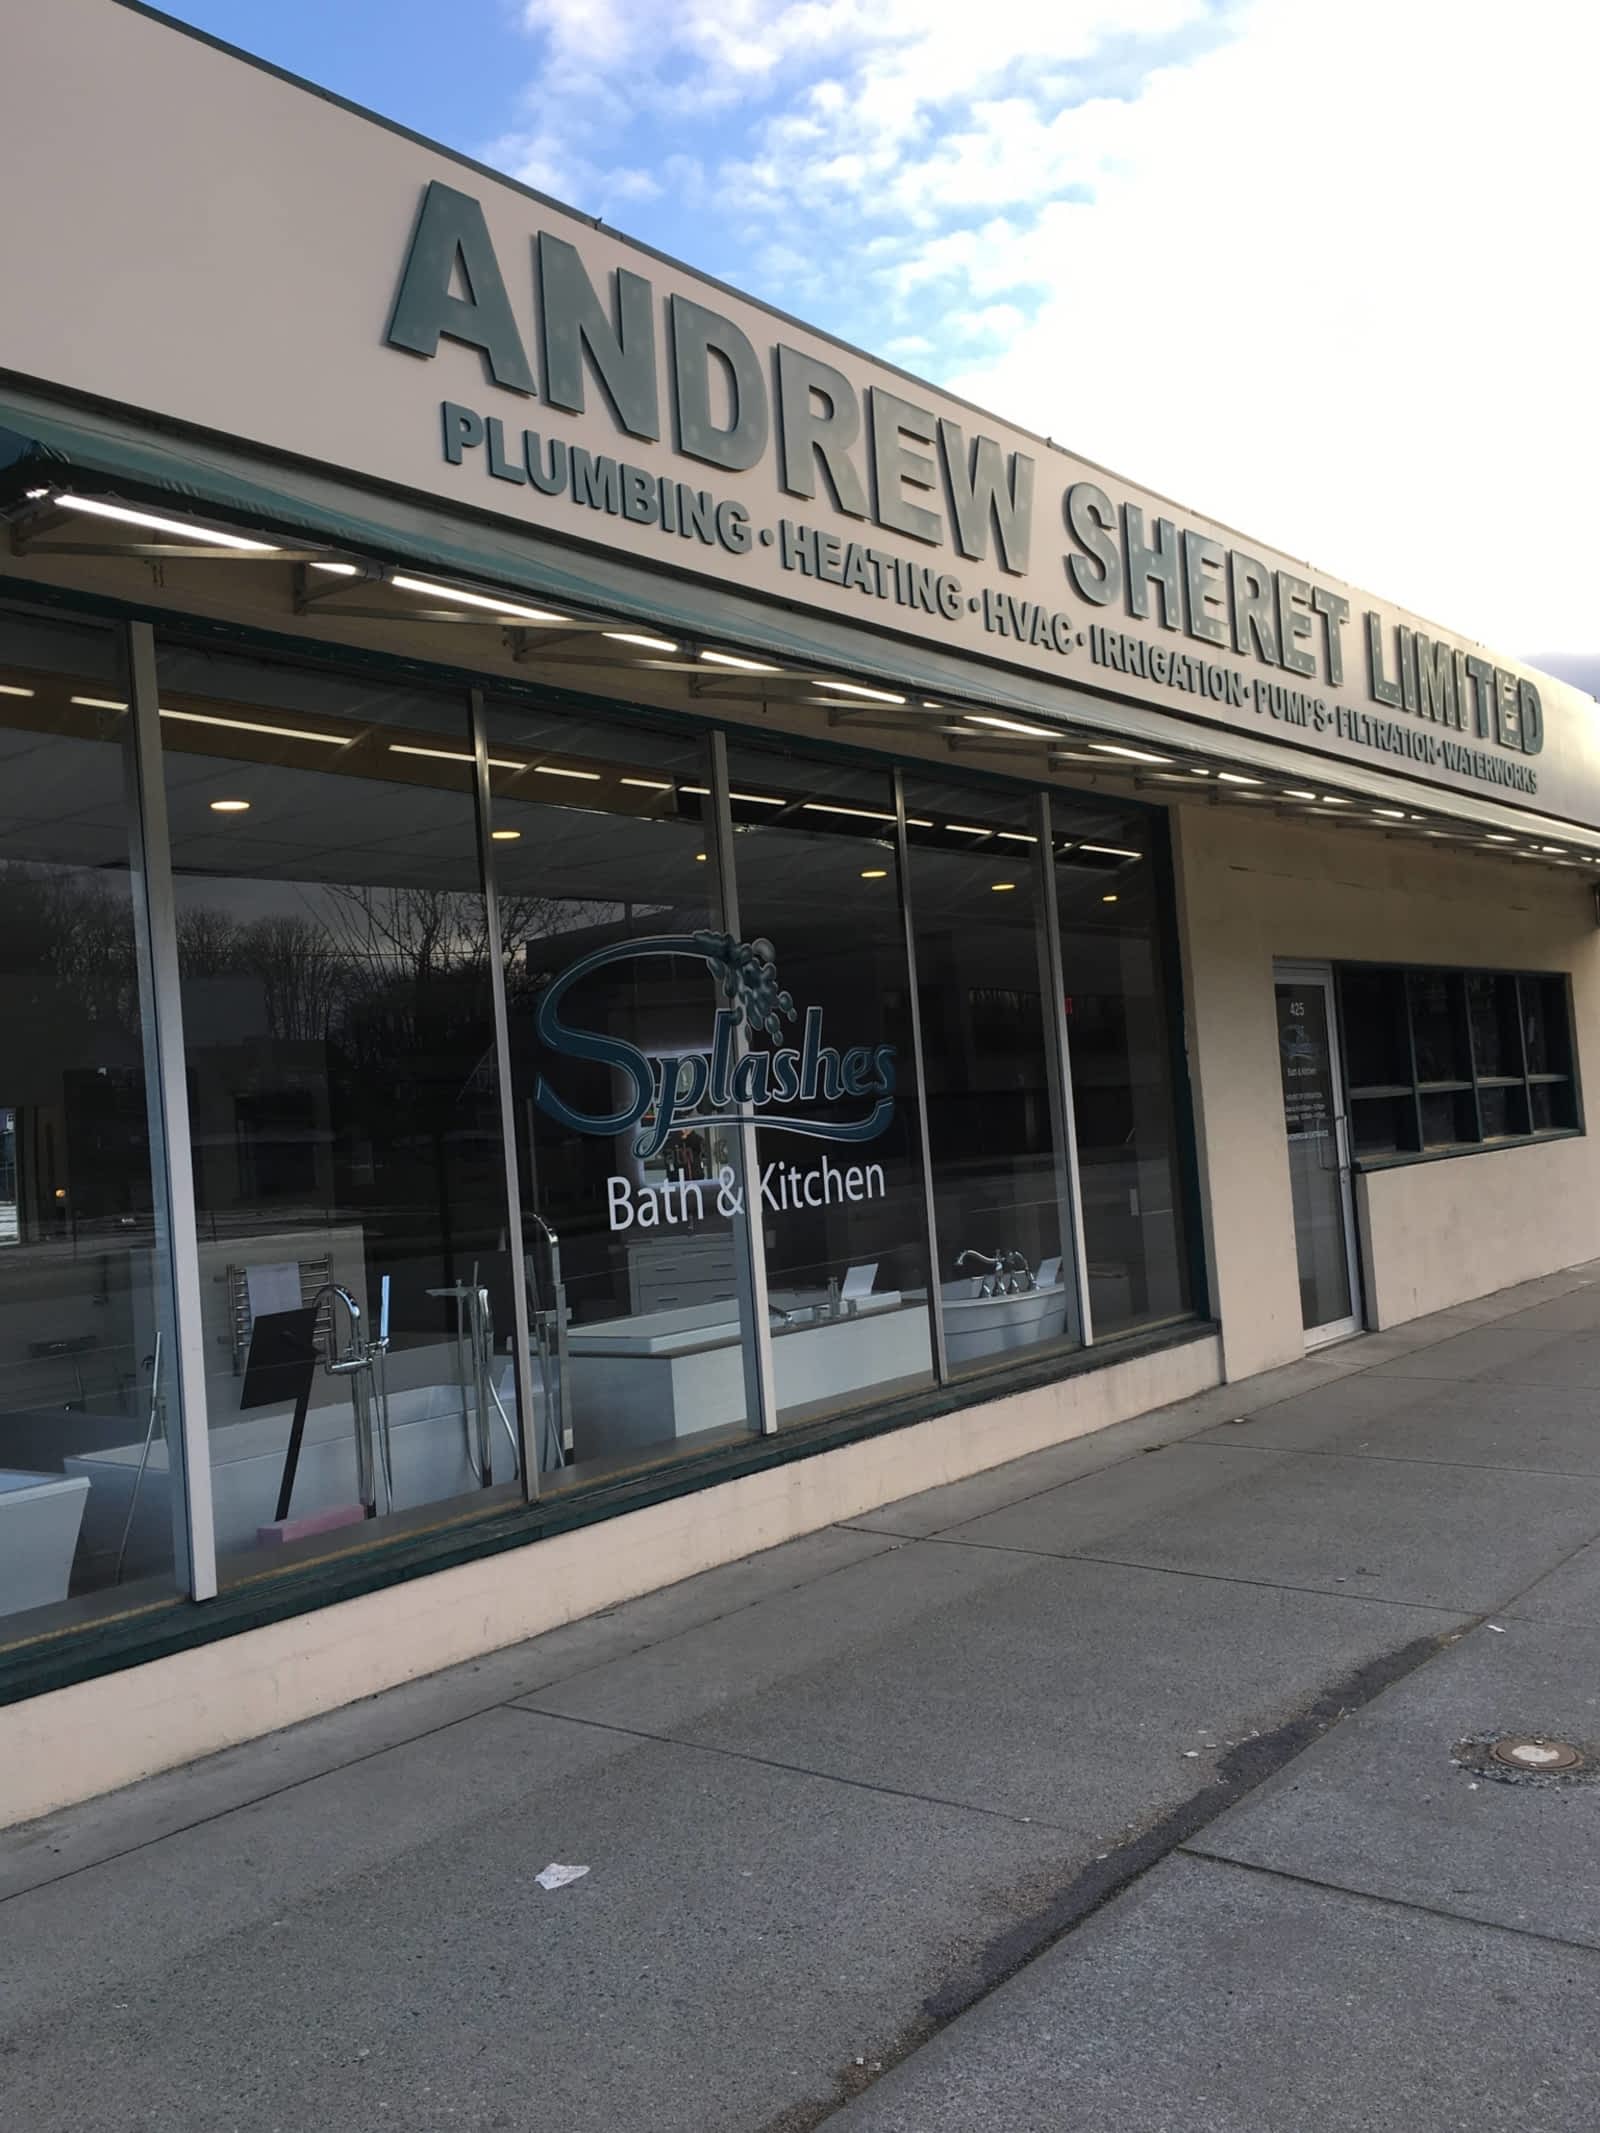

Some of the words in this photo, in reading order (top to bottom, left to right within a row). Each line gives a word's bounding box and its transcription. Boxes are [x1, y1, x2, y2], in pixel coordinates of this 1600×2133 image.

[387, 179, 1035, 576] ANDREW
[1065, 482, 1350, 687] SHERET
[1367, 610, 1545, 756] LIMITED
[441, 400, 753, 556] PLUMBING
[779, 519, 962, 621] HEATING
[982, 588, 1074, 656] HVAC
[1089, 624, 1244, 707] IRRIGATION
[1254, 679, 1327, 732] PUMPS
[1336, 705, 1437, 765] FILTRATION
[1442, 740, 1539, 795] WATERWORKS
[536, 929, 897, 1158] Splashes
[1289, 1002, 1305, 1016] 425
[607, 1168, 704, 1231] Bath
[716, 1165, 745, 1217] &
[757, 1155, 886, 1213] Kitchen
